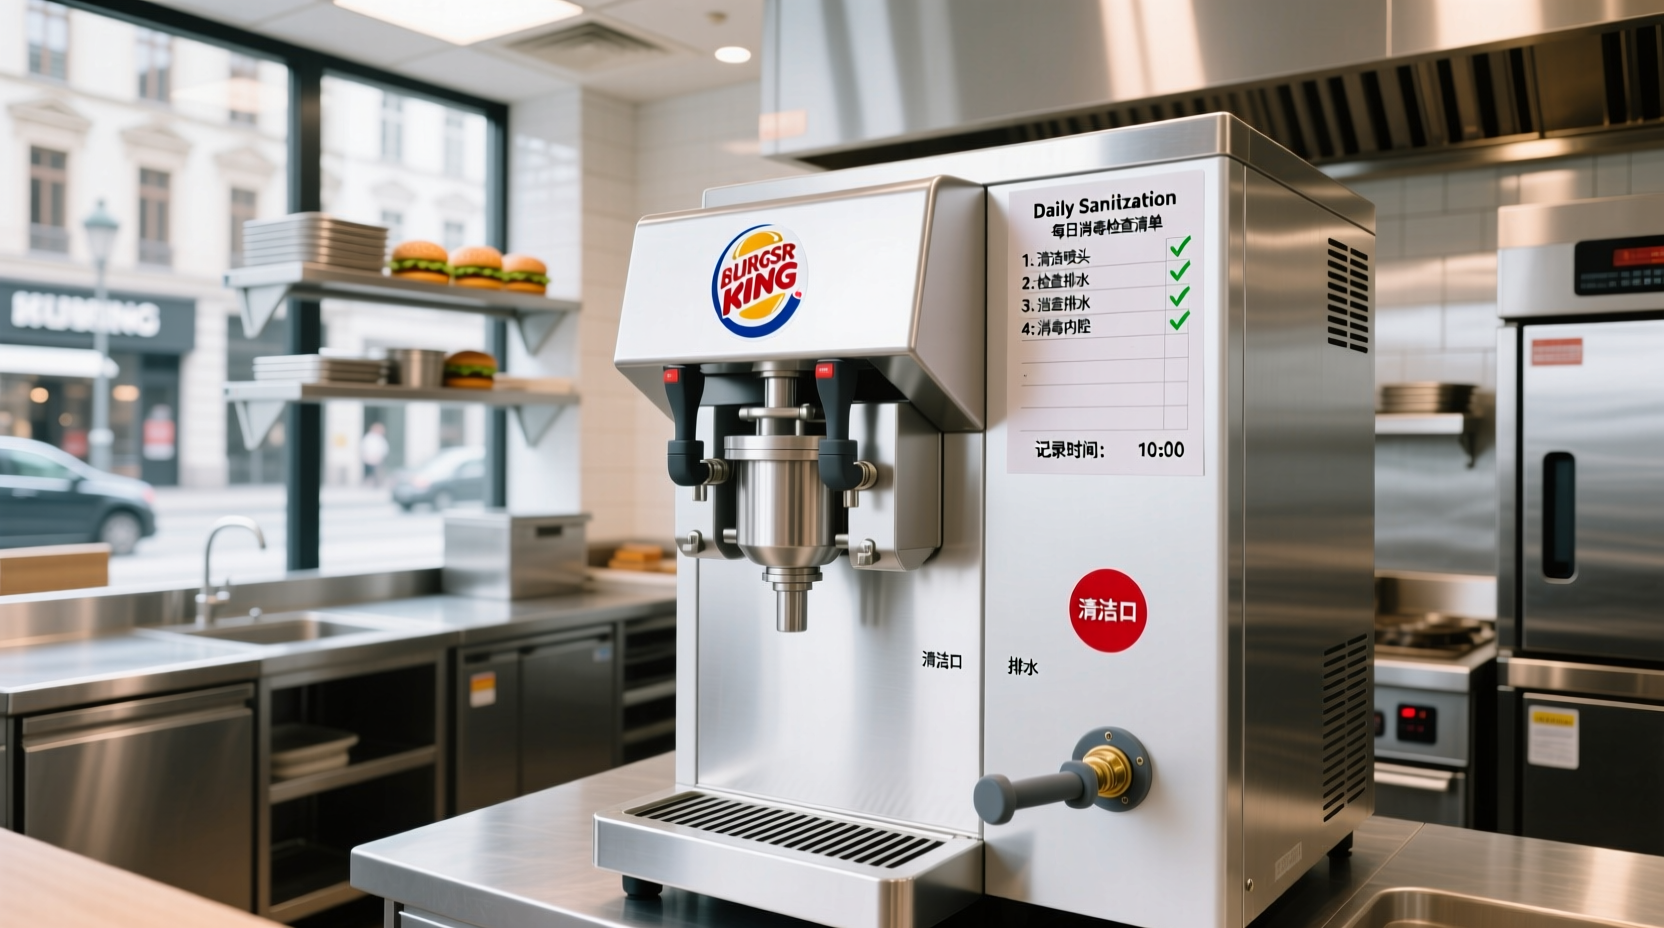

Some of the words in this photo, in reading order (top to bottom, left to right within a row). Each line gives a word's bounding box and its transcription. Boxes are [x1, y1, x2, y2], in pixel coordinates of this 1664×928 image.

[1034, 200, 1075, 219] Daily
[723, 261, 798, 316] KING
[1138, 441, 1185, 458] 10:00
[1078, 598, 1137, 623] 清洁口
[922, 651, 962, 670] 清洁口
[1008, 656, 1039, 676] 排水
